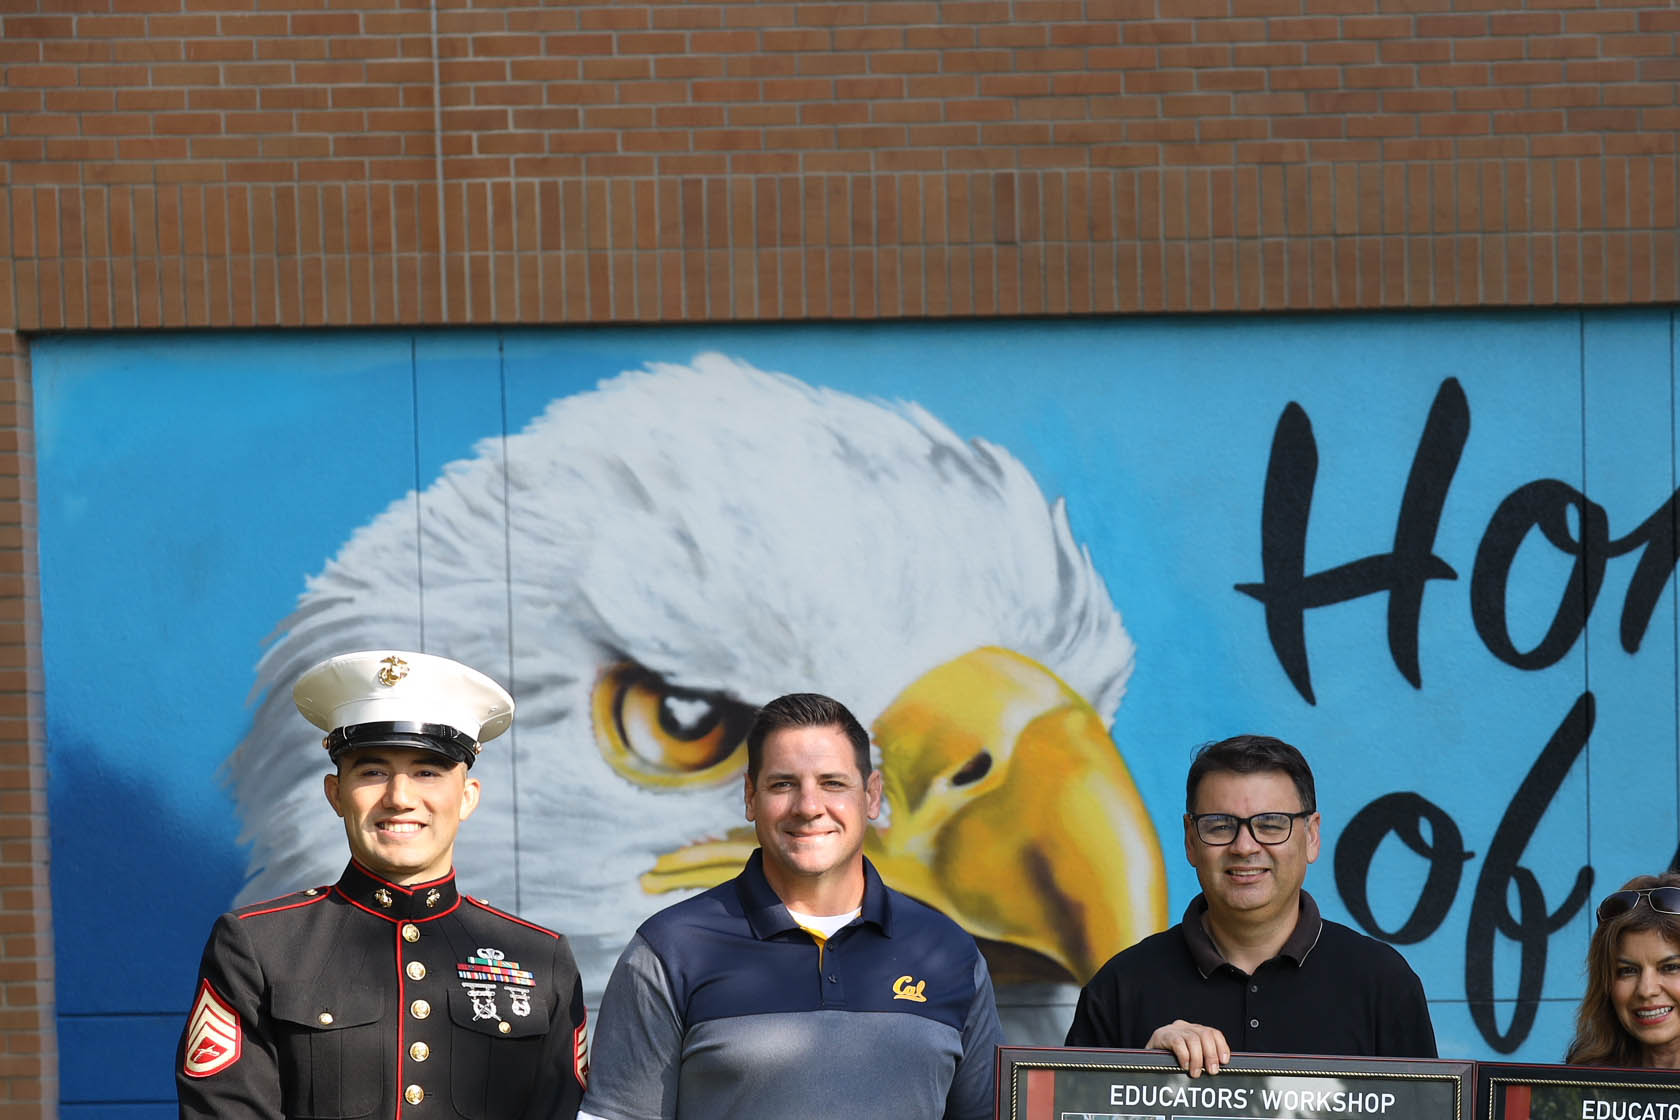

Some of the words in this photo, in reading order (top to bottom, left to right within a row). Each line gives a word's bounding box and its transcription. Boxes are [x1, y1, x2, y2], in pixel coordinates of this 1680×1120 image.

[1333, 690, 1596, 1055] of
[892, 975, 928, 1004] Cal
[1110, 1084, 1254, 1109] EDUCATORS’
[1261, 1089, 1396, 1115] WORKSHOP
